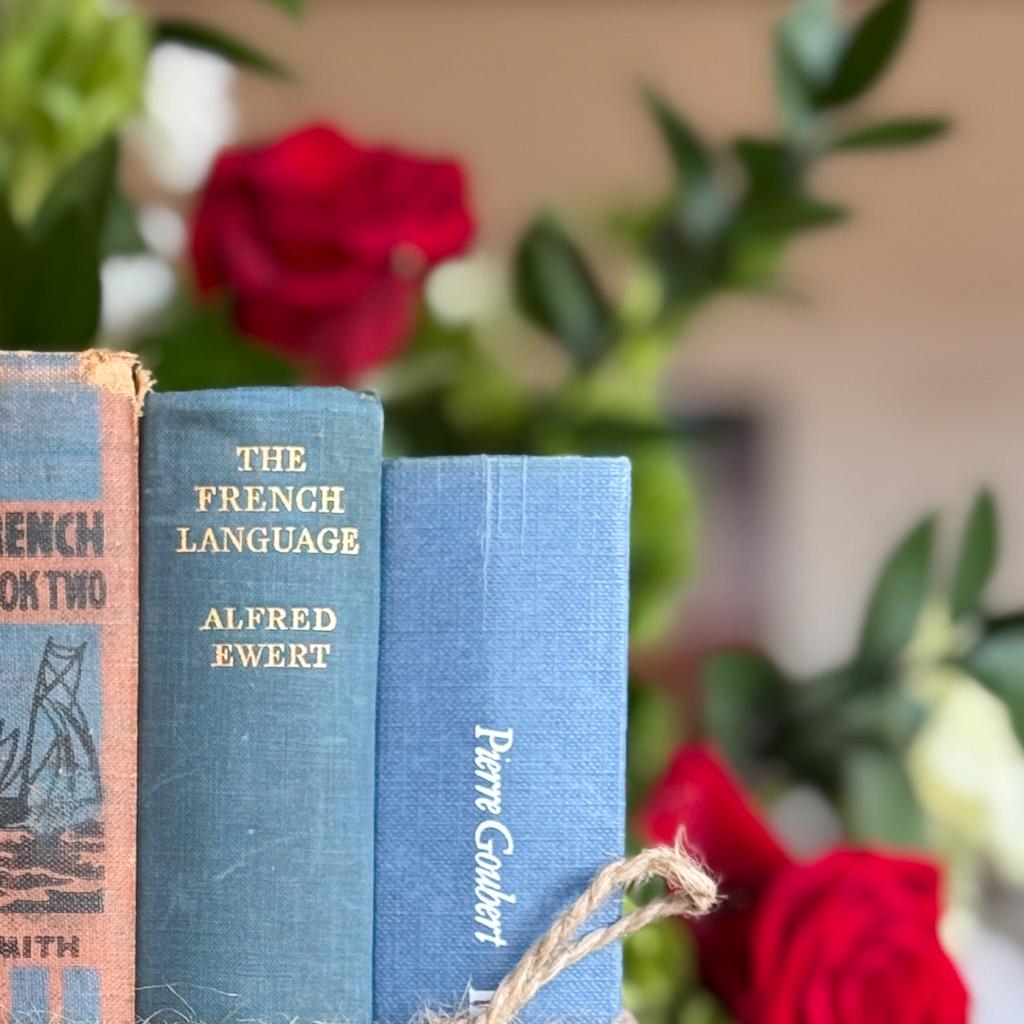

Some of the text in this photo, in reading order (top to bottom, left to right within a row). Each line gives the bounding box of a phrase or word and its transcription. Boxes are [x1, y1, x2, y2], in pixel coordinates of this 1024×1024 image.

[235, 445, 308, 473] THE
[194, 485, 346, 514] FRENCH
[176, 526, 360, 555] LANGUAGE
[43, 569, 107, 611] TWO
[199, 607, 338, 632] ALFRED
[210, 643, 331, 669] EWERT
[474, 724, 517, 948] Pierre Goubert
